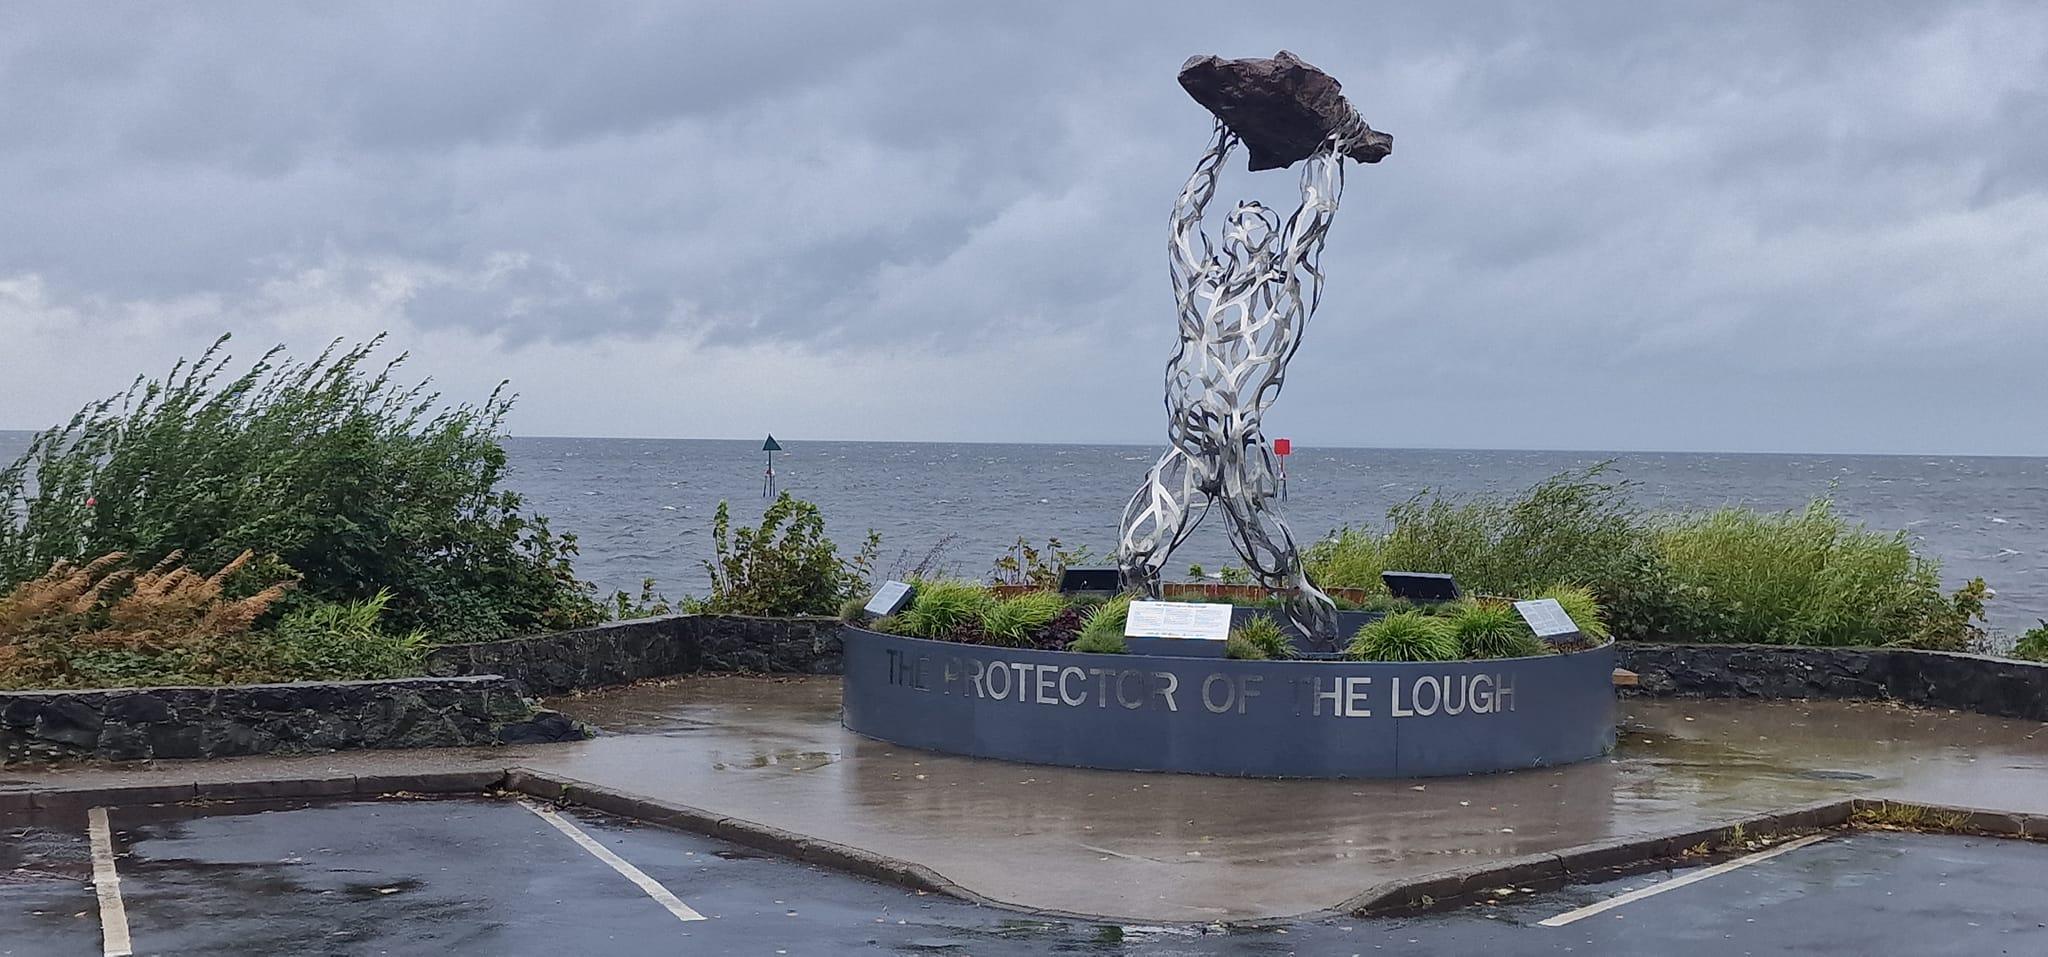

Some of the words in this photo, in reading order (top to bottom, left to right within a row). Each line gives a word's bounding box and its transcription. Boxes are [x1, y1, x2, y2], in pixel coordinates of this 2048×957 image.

[886, 648, 930, 692] THE
[944, 656, 1179, 712] PROTECTOR
[1201, 672, 1264, 715] OF
[1288, 676, 1372, 717] HE
[1391, 674, 1516, 717] LOUGH
